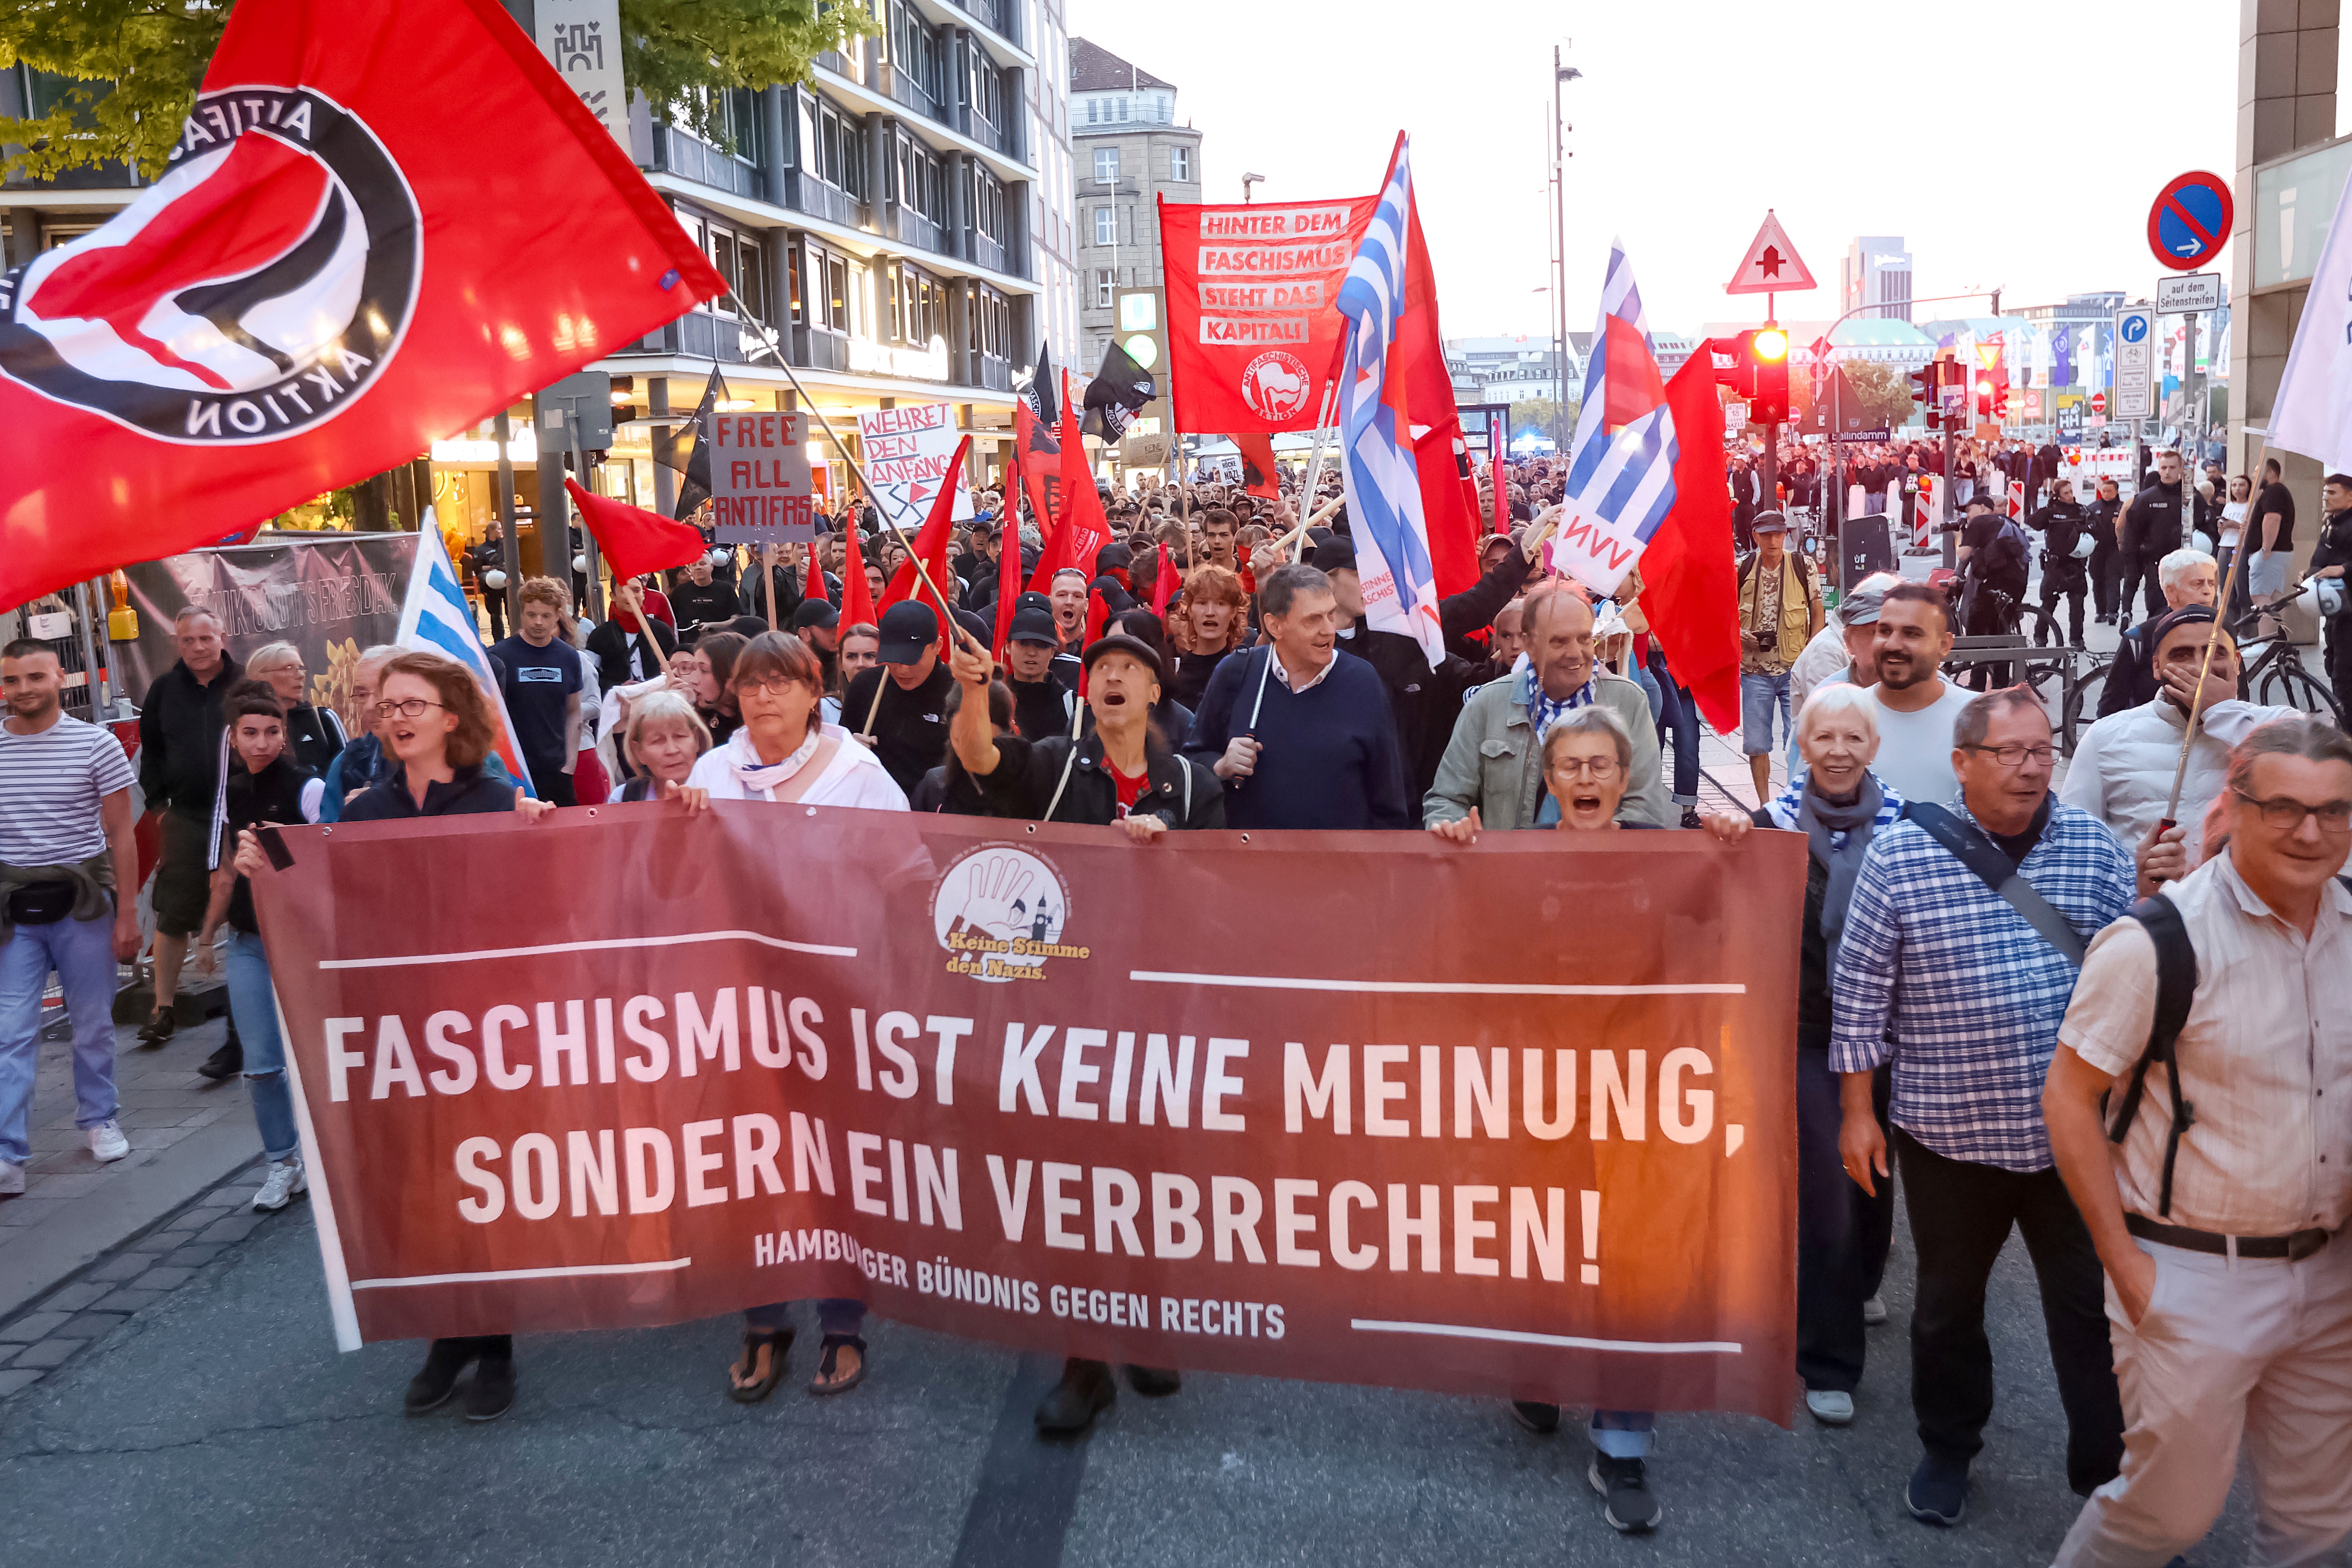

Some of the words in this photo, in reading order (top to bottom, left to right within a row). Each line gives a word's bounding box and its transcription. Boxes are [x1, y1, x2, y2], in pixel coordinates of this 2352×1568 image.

[1207, 215, 1287, 235] HINTER
[1295, 213, 1341, 234] DEM
[1205, 245, 1346, 271] FASCHISMUS
[1205, 287, 1268, 307] STEHT
[1274, 285, 1318, 306] DAS
[2160, 294, 2215, 307] Seitenstreifen
[2171, 283, 2184, 294] auf
[2188, 282, 2205, 292] dem
[1243, 352, 1309, 388] ANTIFASCHISTISCHE
[861, 403, 950, 435] WEHRET
[1253, 407, 1298, 421] AKTION
[718, 416, 797, 447] FREE
[864, 435, 917, 459] DEN
[731, 459, 791, 490] ALL
[871, 454, 969, 491] ANFÄNGN
[1222, 460, 1237, 469] HÖCKE
[1224, 469, 1239, 481] NAZI
[715, 495, 812, 527] ANTIFAS
[949, 932, 1009, 954] Keine
[1013, 937, 1091, 959] Stimme
[946, 957, 983, 976] den
[988, 959, 1047, 981] Nazis.
[324, 986, 828, 1102] FASCHISMUS
[850, 1007, 976, 1105] IST
[998, 1021, 1249, 1132] KEINE
[1283, 1041, 1745, 1158] MEINUNG,
[454, 1111, 836, 1224] SONDERN
[846, 1130, 964, 1232] EIN
[987, 1154, 1601, 1285] VERBRECHEN!
[754, 1229, 909, 1288] HAMBURGER
[917, 1257, 1041, 1313] BÜNDNIS
[1050, 1286, 1149, 1330] GEGEN
[1161, 1298, 1286, 1340] RECHTS
